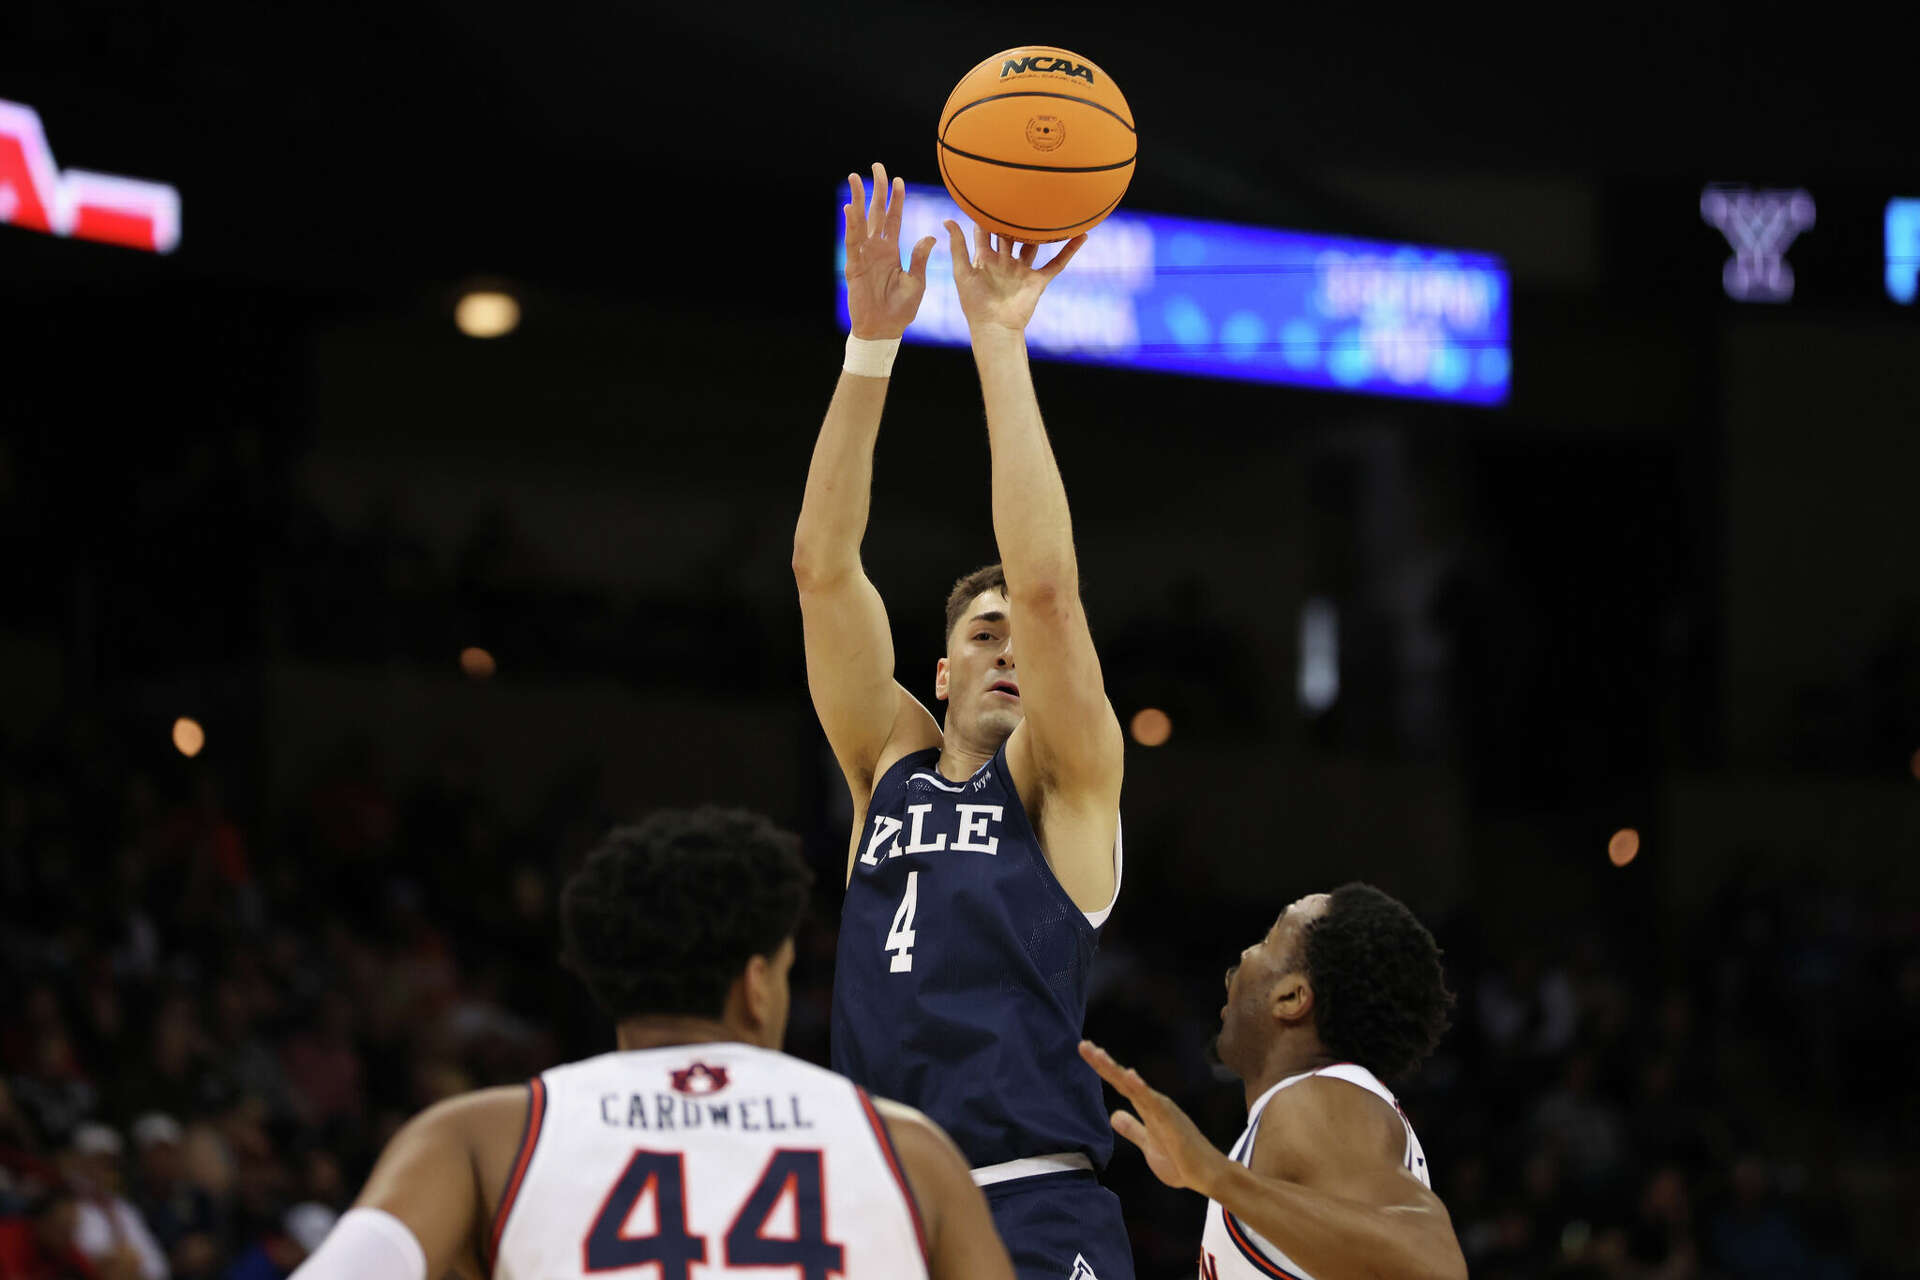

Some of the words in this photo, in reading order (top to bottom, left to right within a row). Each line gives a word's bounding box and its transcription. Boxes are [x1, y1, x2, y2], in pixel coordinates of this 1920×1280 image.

[1000, 57, 1094, 85] NCAA
[884, 871, 918, 973] 4
[600, 1094, 814, 1131] CARDWELL
[583, 1147, 846, 1280] 44
